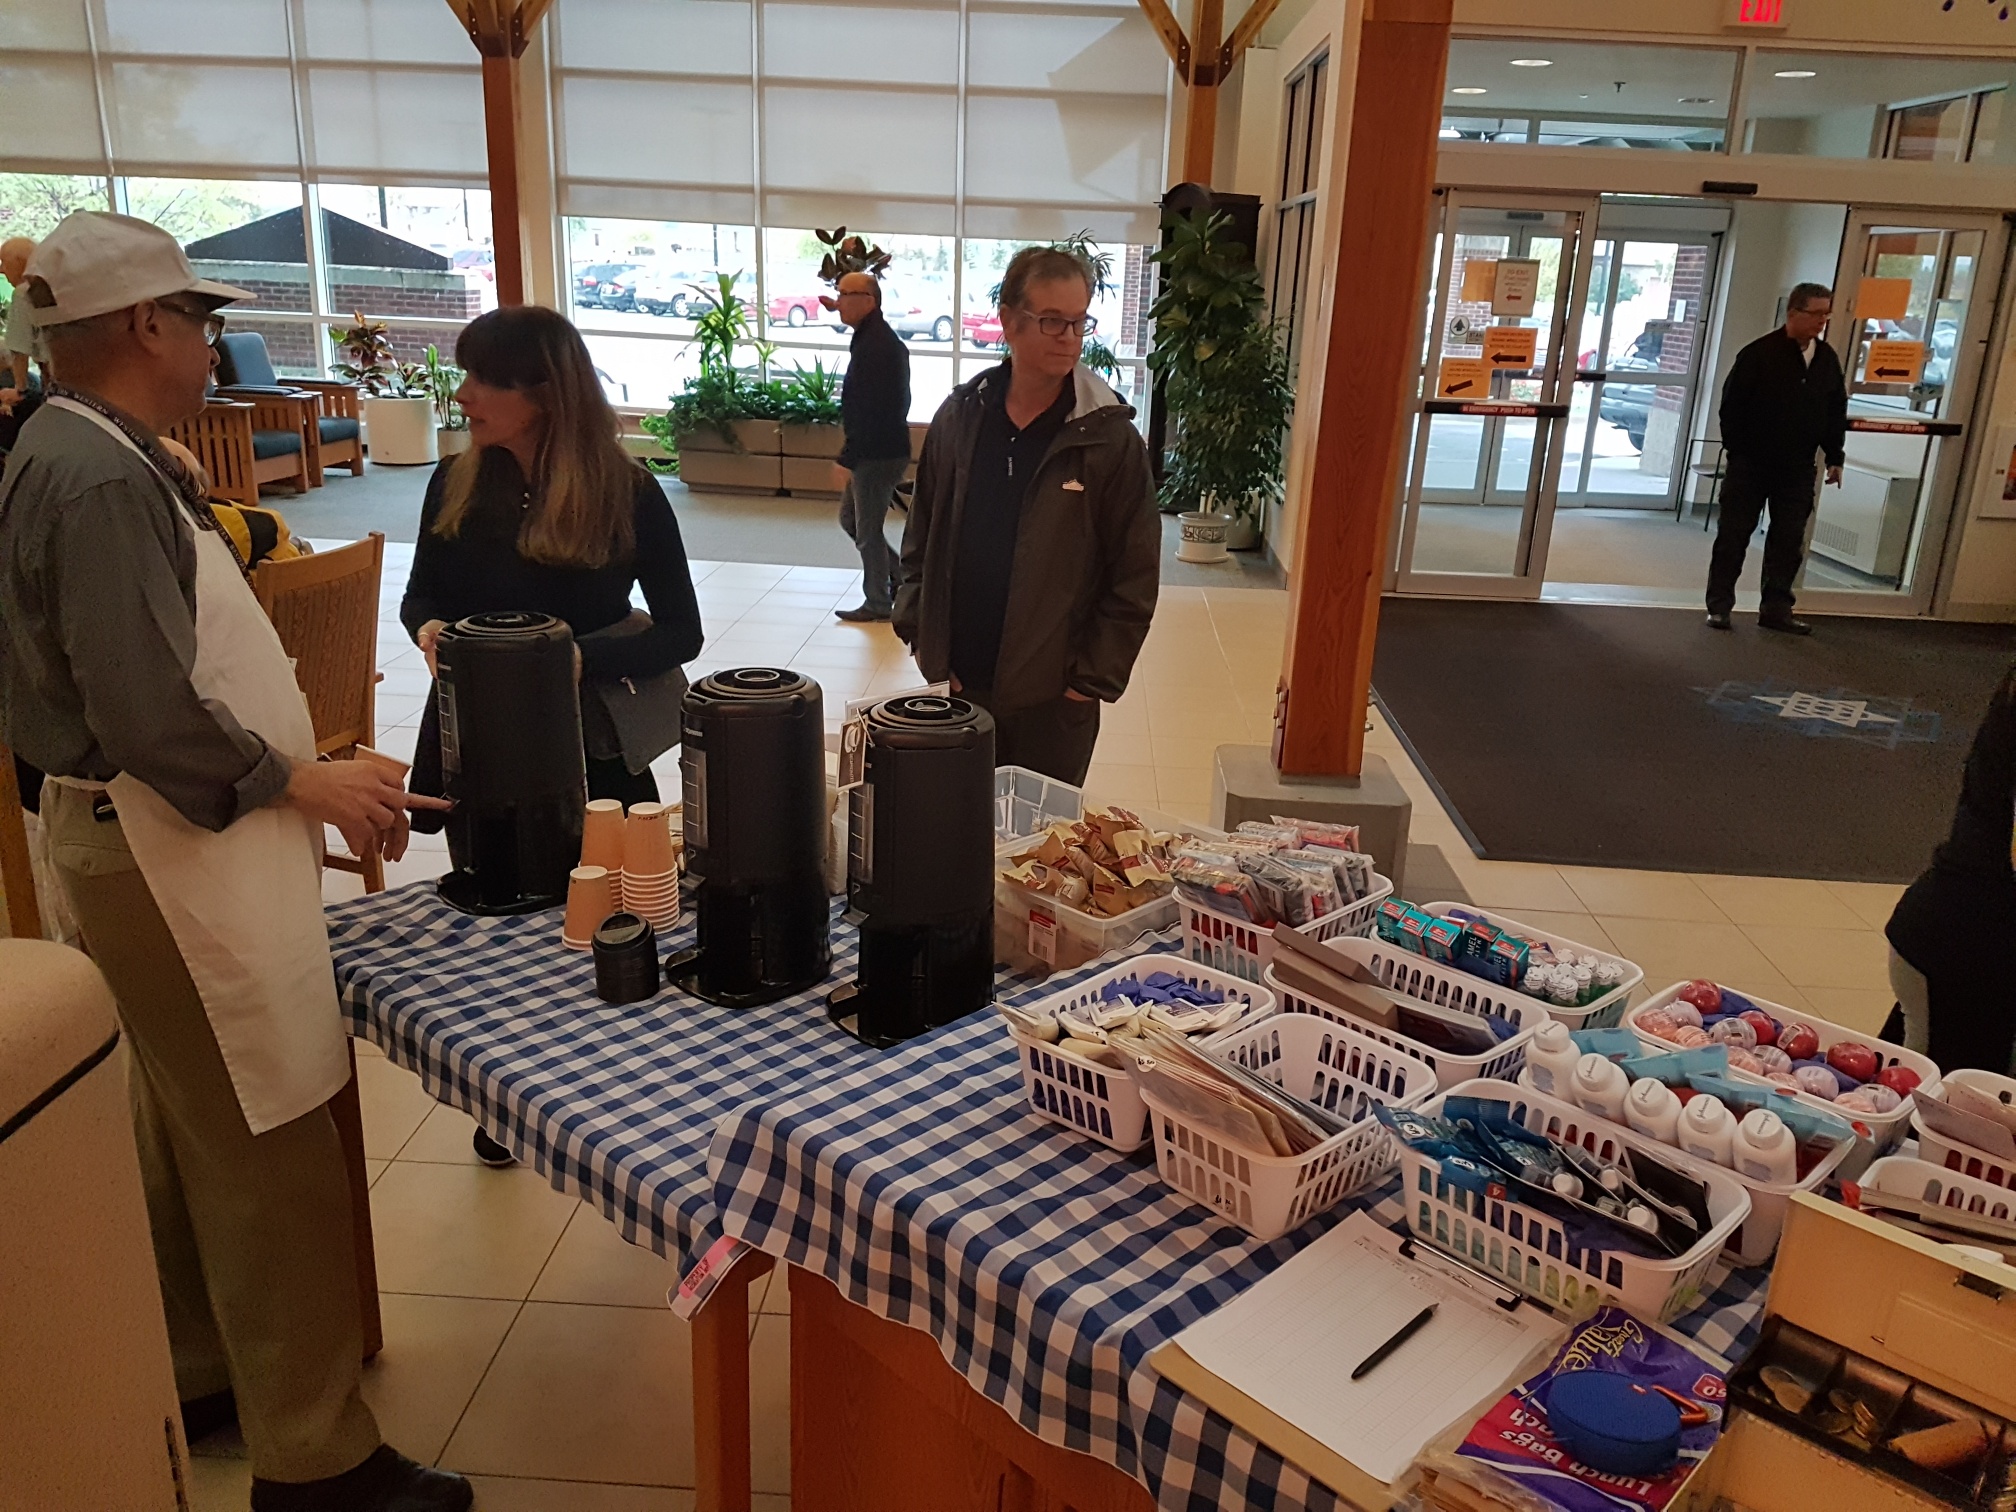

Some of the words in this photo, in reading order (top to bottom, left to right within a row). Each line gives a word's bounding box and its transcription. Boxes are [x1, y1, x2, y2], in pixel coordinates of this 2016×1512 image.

[1562, 1324, 1622, 1371] Value
[1609, 1319, 1644, 1358] Great
[1510, 1408, 1556, 1437] nch
[1500, 1429, 1565, 1466] Bags
[1569, 1460, 1654, 1496] Lunch
